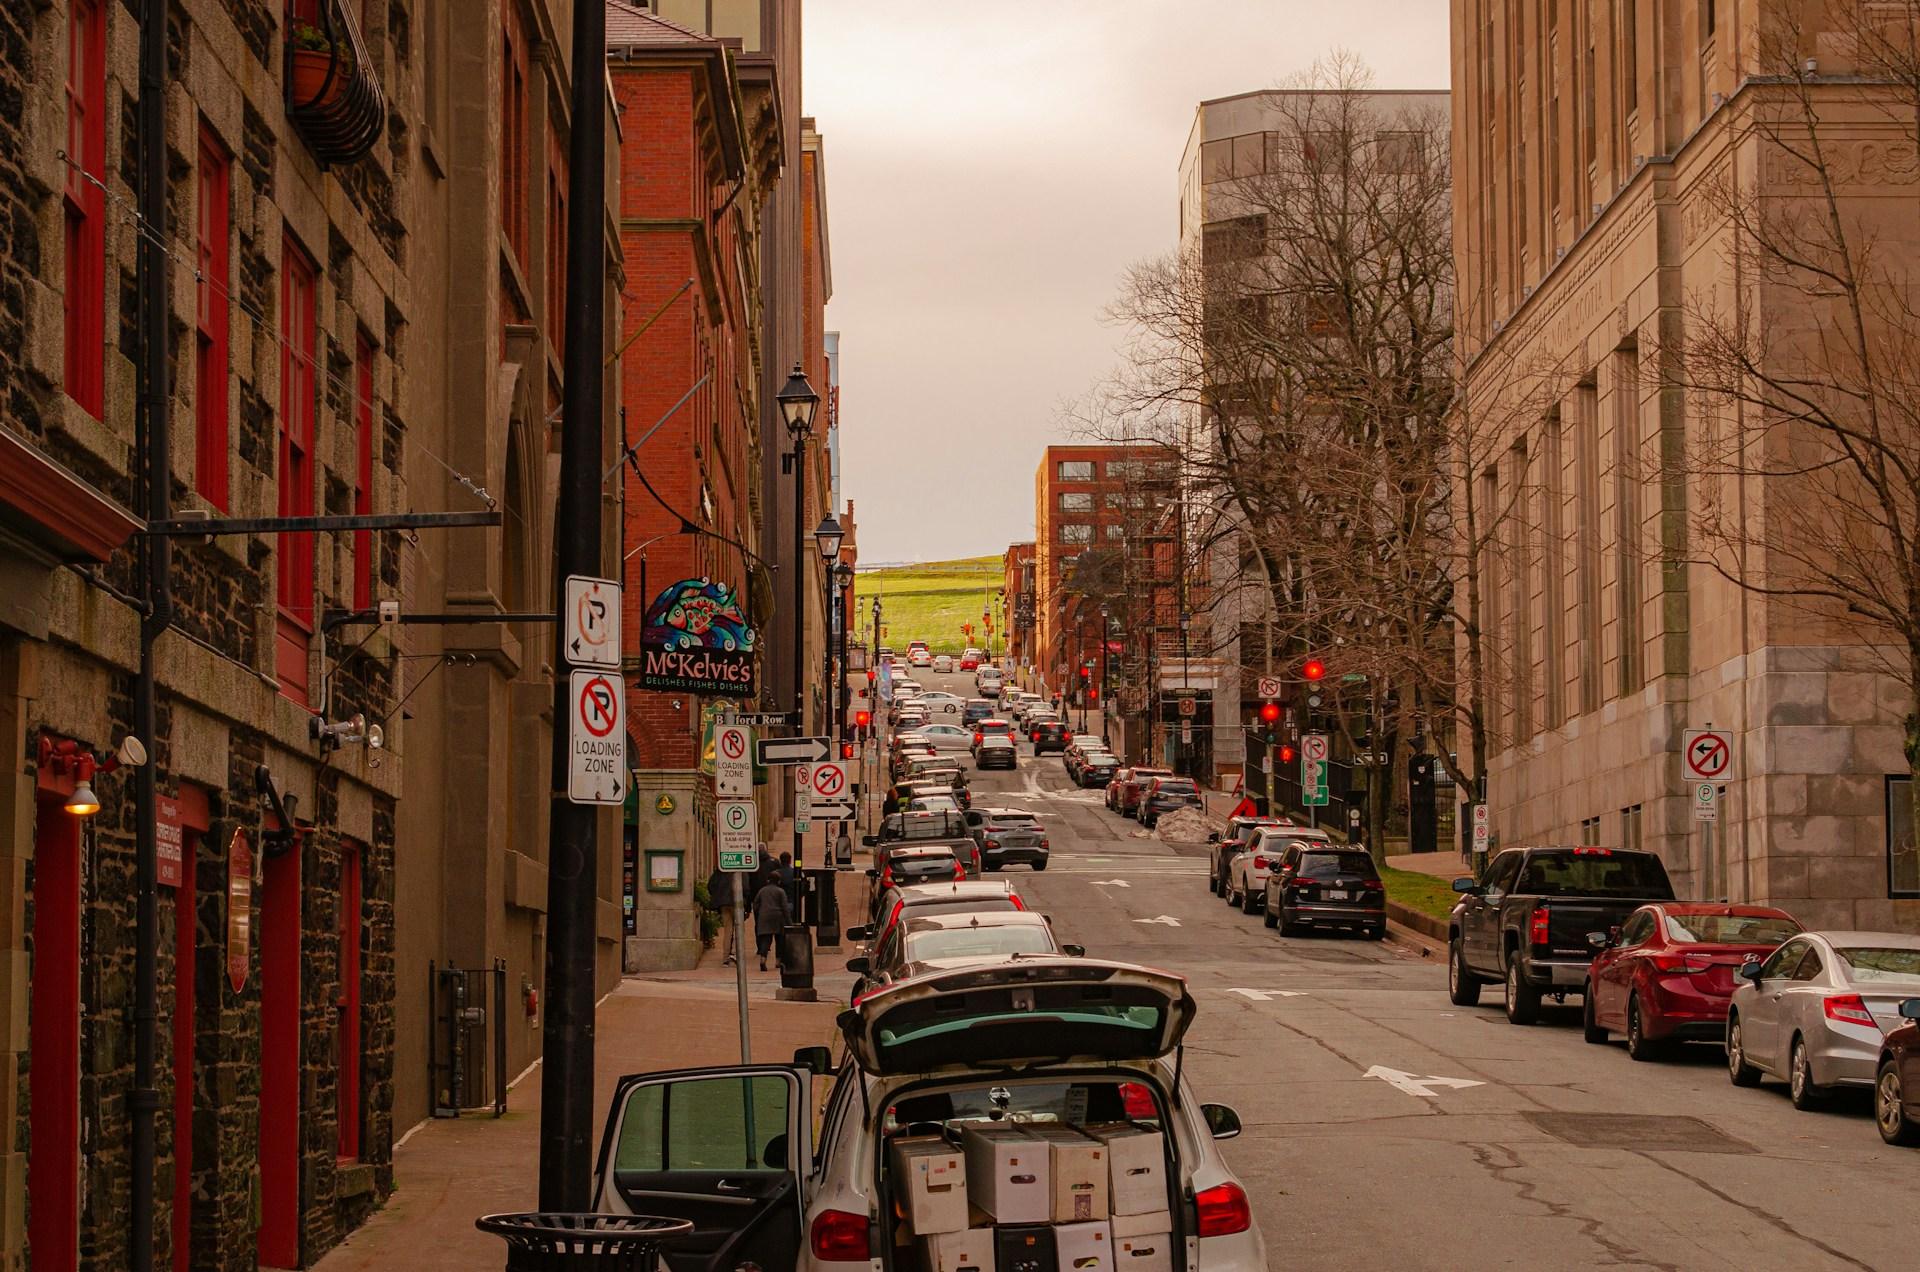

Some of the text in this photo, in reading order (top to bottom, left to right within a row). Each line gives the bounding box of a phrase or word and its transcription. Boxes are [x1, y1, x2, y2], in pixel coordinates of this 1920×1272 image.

[1575, 278, 1604, 332] SCOTIA
[645, 650, 751, 682] McKelvie's
[646, 676, 685, 687] DELISHES
[720, 682, 749, 692] DISHES
[716, 714, 783, 725] Bford Row
[576, 740, 622, 757] LOADING
[585, 758, 614, 774] ZONE
[717, 761, 750, 770] LOADING
[724, 769, 745, 778] ZONE
[723, 854, 752, 865] PAY B
